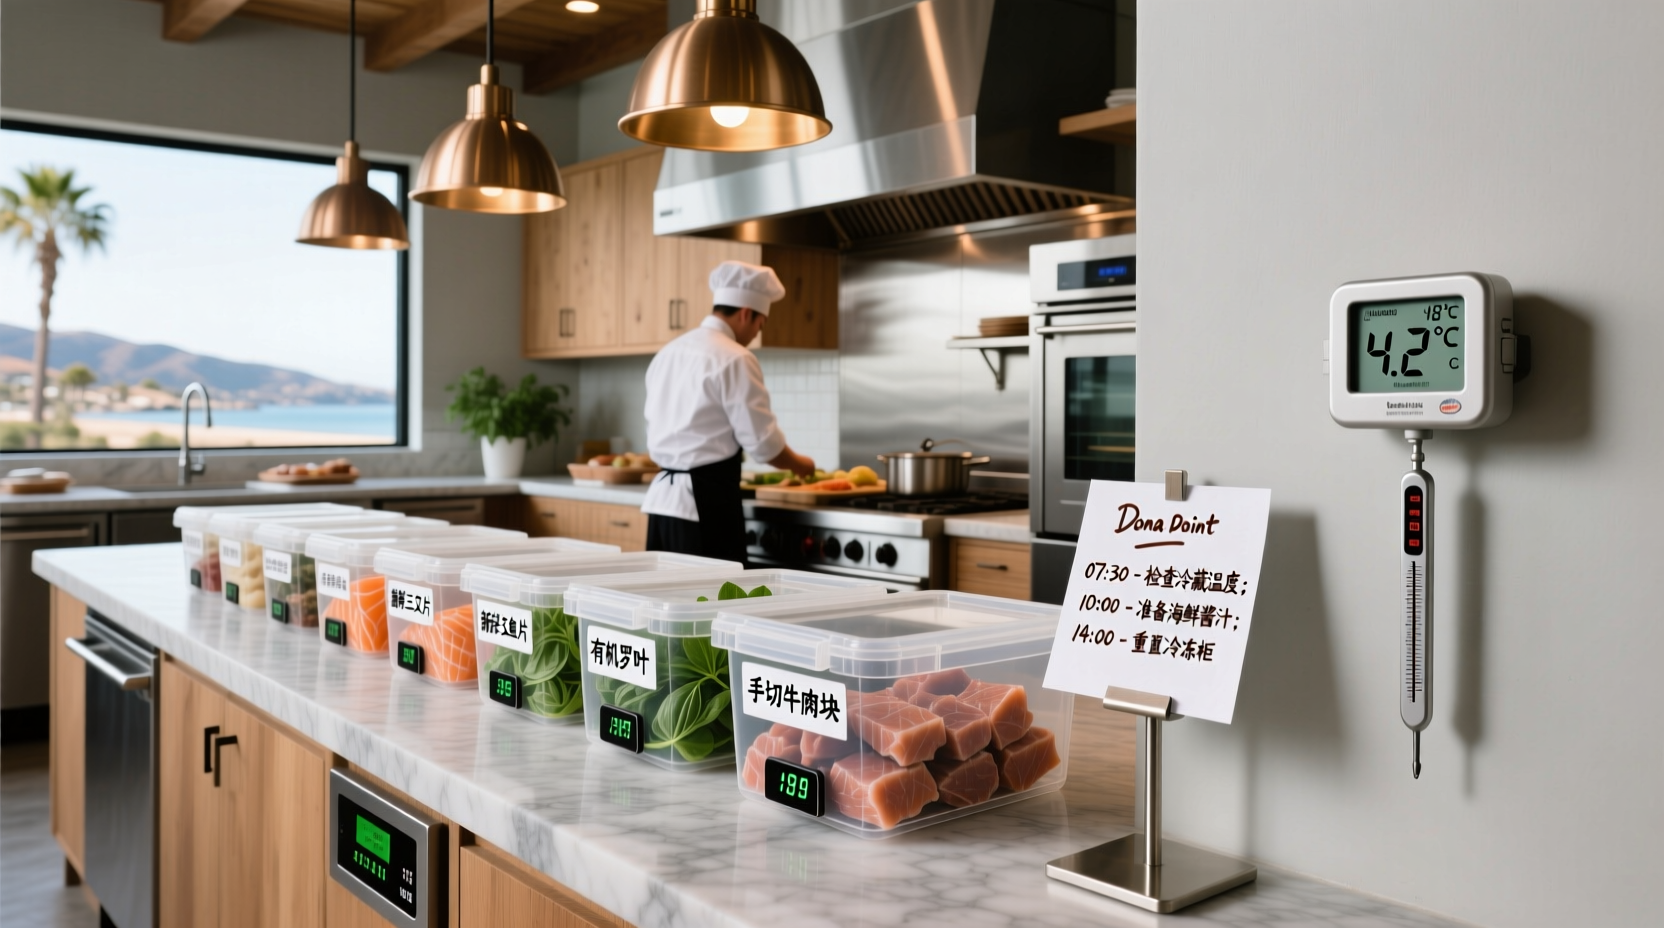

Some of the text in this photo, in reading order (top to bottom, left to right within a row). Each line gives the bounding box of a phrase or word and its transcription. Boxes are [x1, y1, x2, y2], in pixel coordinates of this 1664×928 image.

[1114, 503, 1164, 534] Dona
[1084, 562, 1129, 582] 07:30
[1079, 594, 1120, 613] 10:00
[1072, 624, 1115, 646] 14:00
[748, 676, 840, 723] 手切牛肉块
